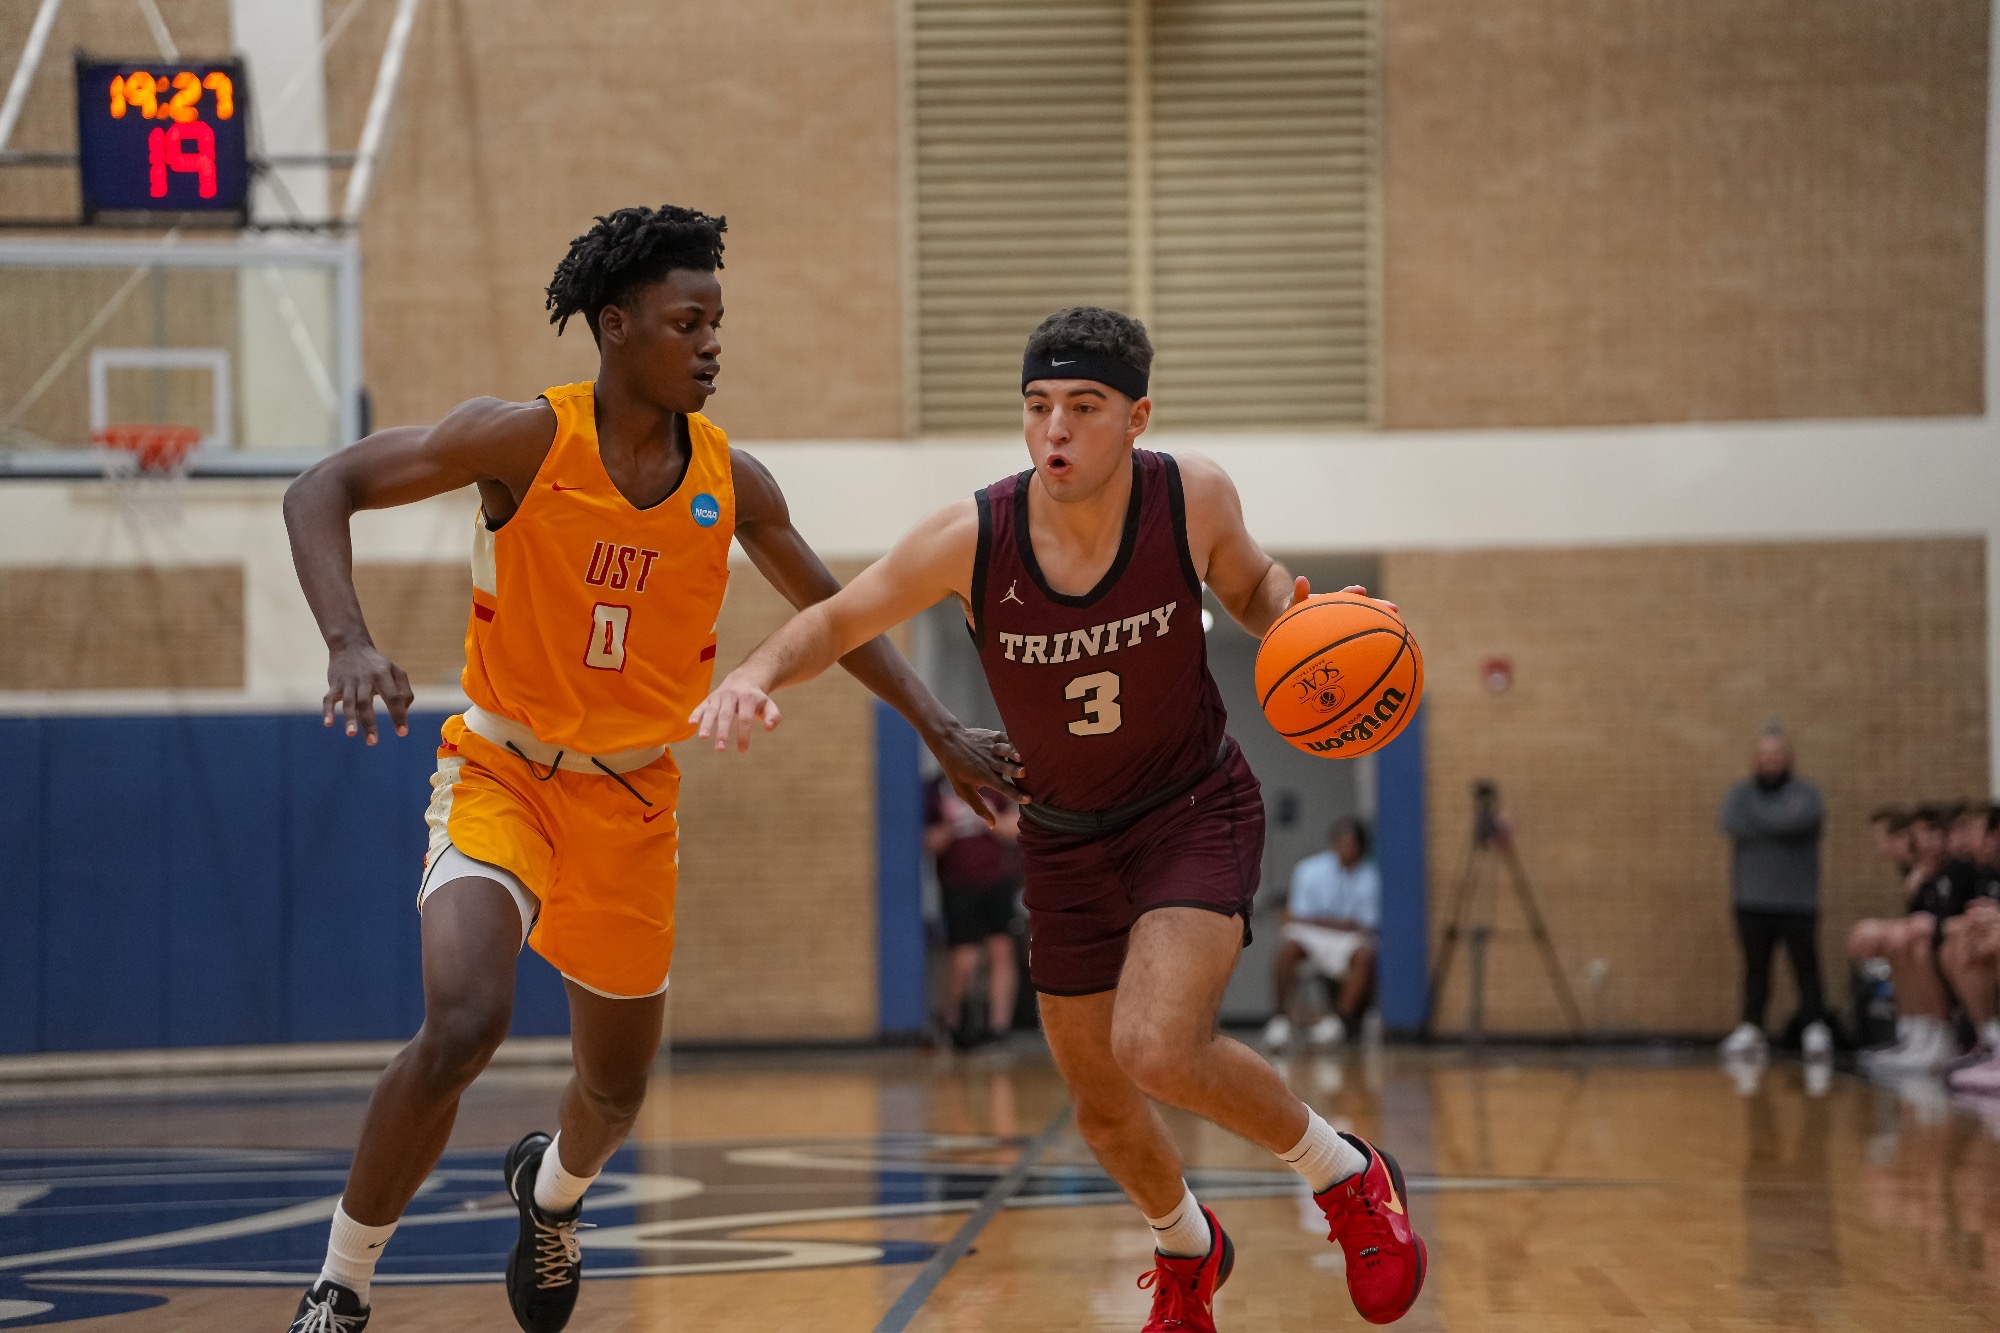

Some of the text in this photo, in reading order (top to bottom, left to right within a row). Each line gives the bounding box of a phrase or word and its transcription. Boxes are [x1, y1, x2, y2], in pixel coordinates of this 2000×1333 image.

[110, 71, 234, 123] 19:27
[149, 121, 217, 198] 19
[695, 508, 718, 520] NCAA
[585, 541, 660, 593] UST
[583, 602, 632, 673] 0
[1000, 601, 1177, 664] TRINITY
[1064, 670, 1122, 737] 3
[1291, 661, 1340, 700] SCAC
[1301, 687, 1407, 752] Wilson
